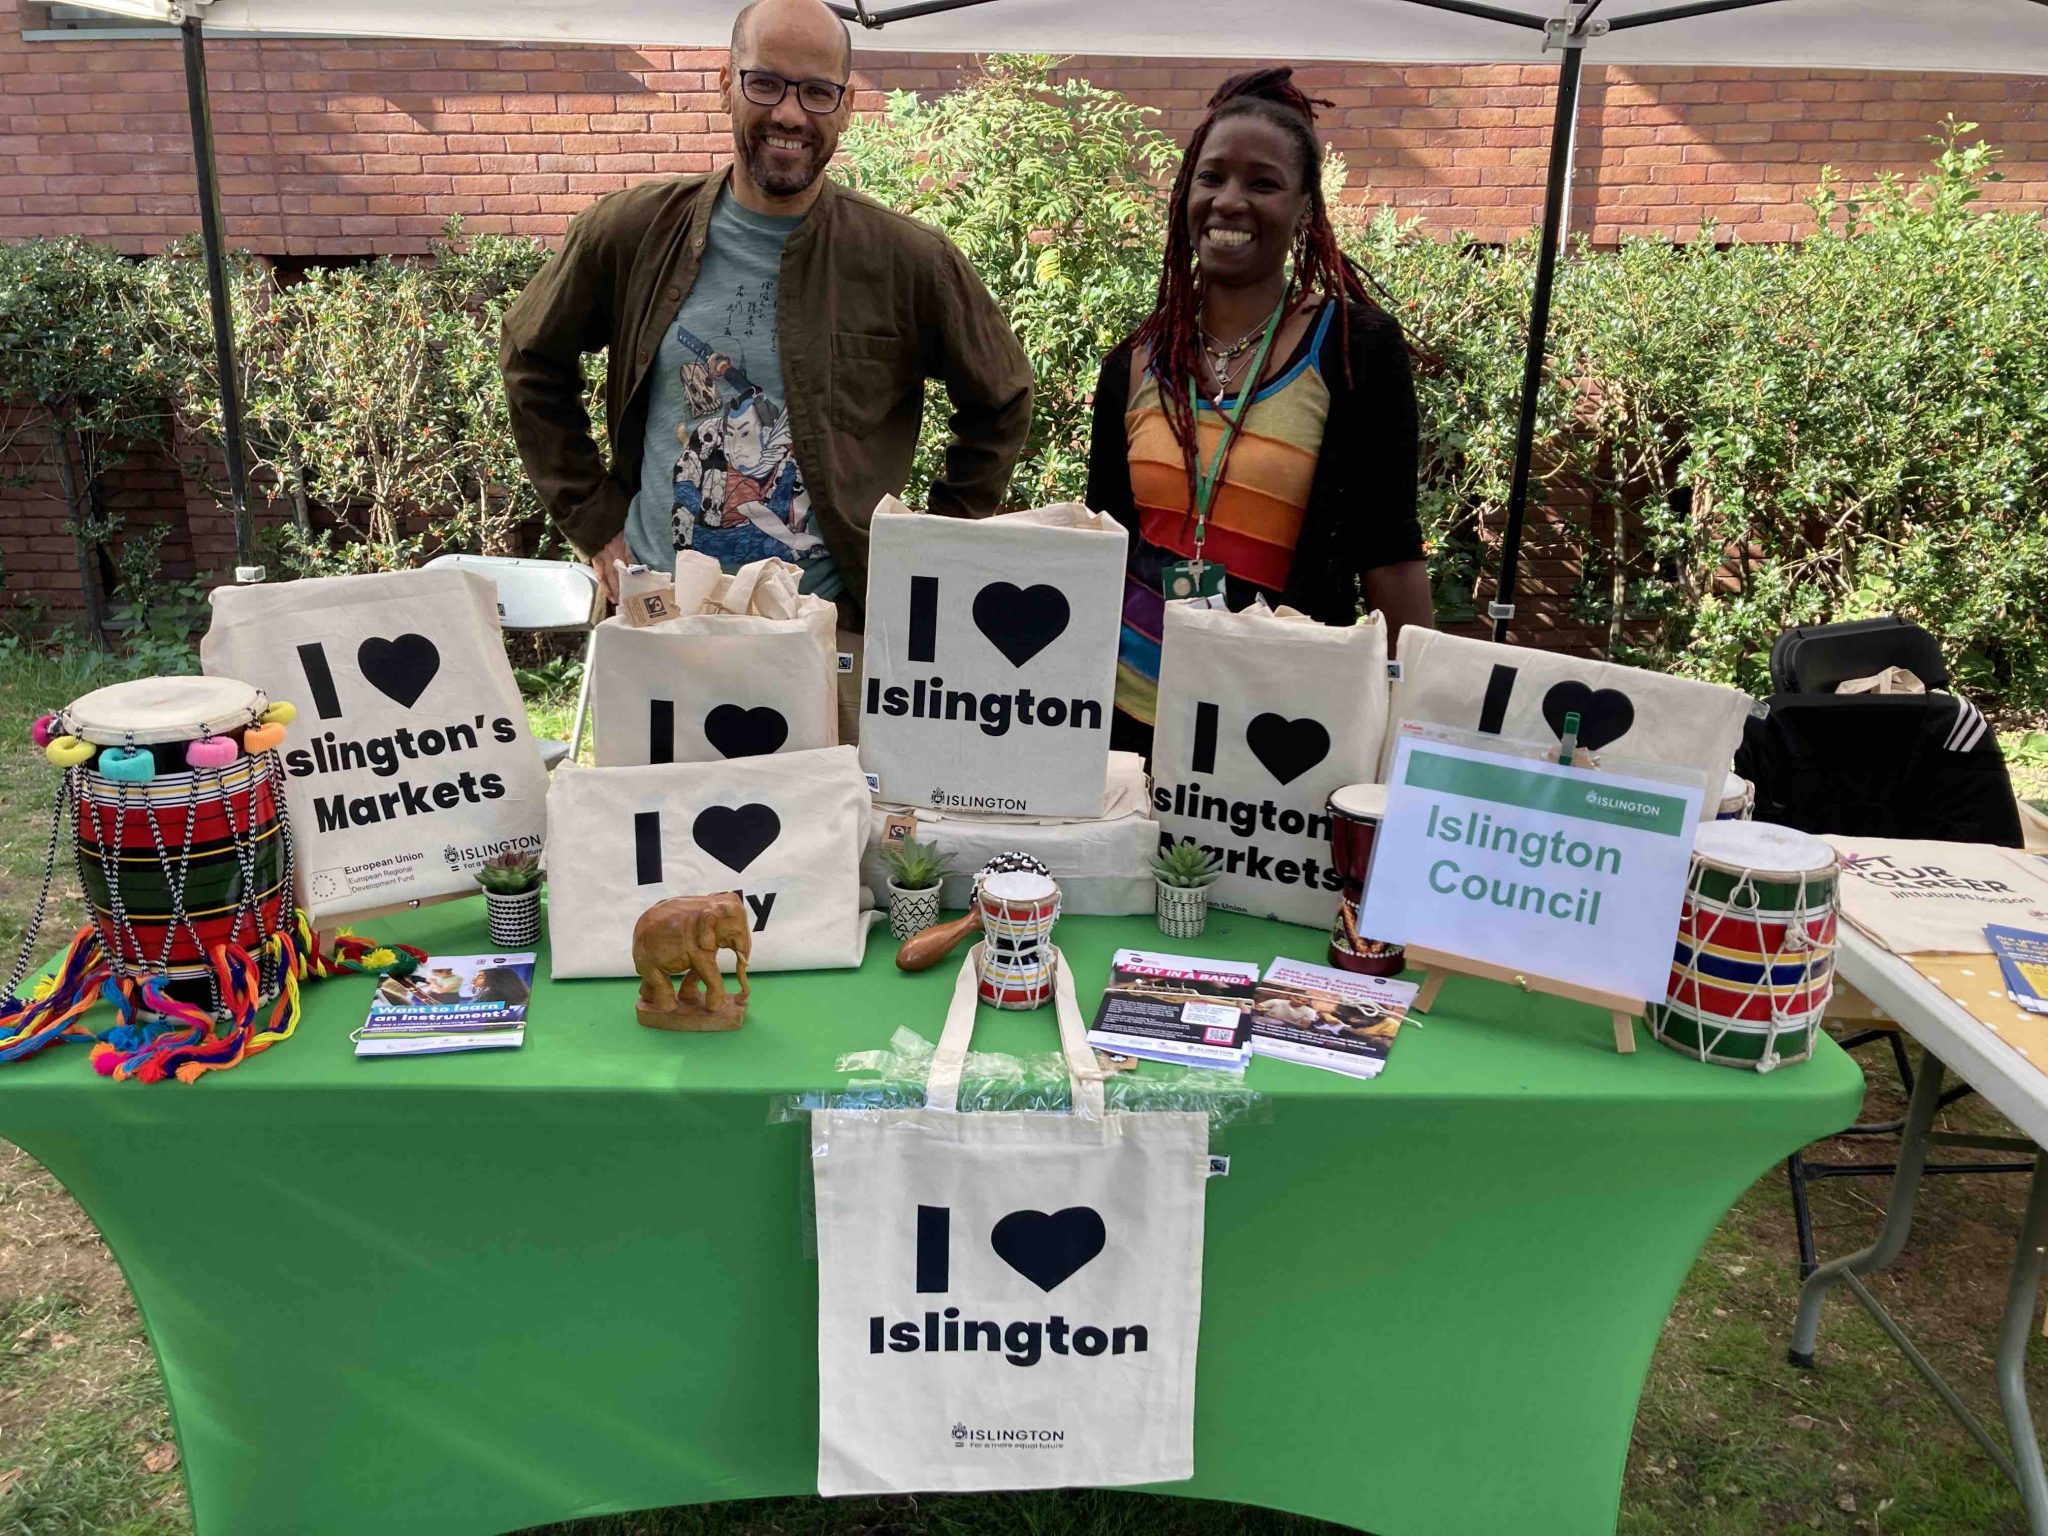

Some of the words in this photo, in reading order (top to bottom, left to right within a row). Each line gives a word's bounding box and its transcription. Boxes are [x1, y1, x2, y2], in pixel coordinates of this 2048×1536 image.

[908, 576, 938, 662] I
[296, 642, 342, 720] I
[866, 676, 1101, 736] Islington
[1478, 664, 1518, 734] I
[650, 699, 674, 764] I
[1192, 701, 1219, 774] I
[313, 772, 505, 833] Markets
[946, 795, 1026, 810] ISLINGTON
[1151, 779, 1332, 841] slington
[1597, 796, 1660, 816] ISLINGTON
[344, 858, 393, 875] European
[395, 851, 424, 865] Union
[460, 834, 541, 861] ISLINGTON
[634, 811, 662, 885] I
[1425, 805, 1621, 875] Islington
[348, 872, 382, 884] European
[383, 866, 413, 877] Regional
[351, 878, 397, 893] Development
[398, 874, 415, 883] Fund
[1428, 859, 1601, 926] Council
[1126, 965, 1164, 975] PLAY
[1166, 969, 1183, 978] IN
[1184, 971, 1195, 979] A
[1199, 974, 1246, 985] BAND!
[378, 1005, 425, 1014] Want
[436, 1005, 449, 1013] to
[454, 1003, 500, 1012] learn
[916, 1205, 950, 1293] I
[870, 1307, 1148, 1367] Islington
[970, 1430, 1064, 1441] ISLINGTON
[1015, 1442, 1038, 1450] equal
